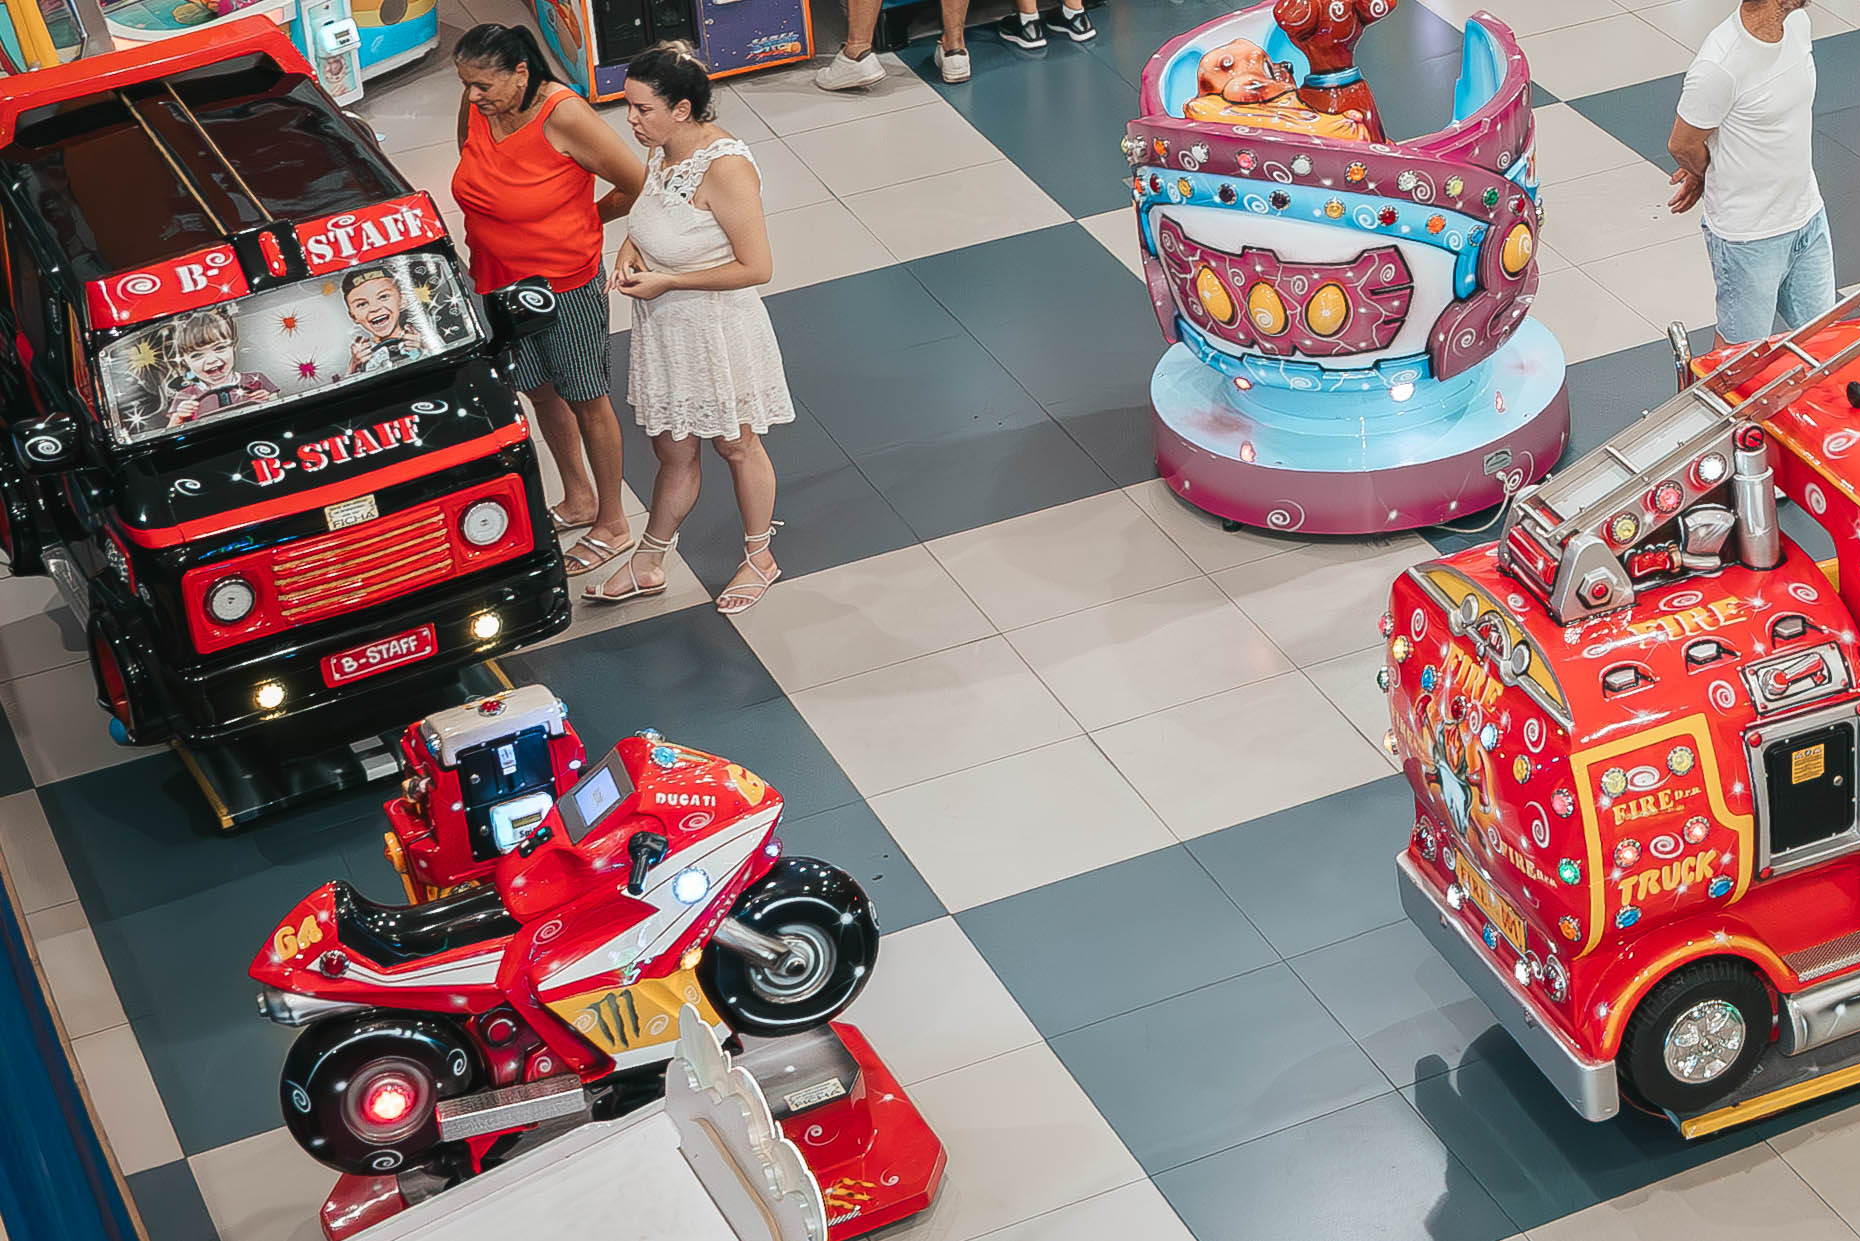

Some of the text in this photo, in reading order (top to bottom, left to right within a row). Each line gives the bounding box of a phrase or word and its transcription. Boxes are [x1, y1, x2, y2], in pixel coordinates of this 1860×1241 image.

[307, 207, 425, 265] STAFF
[251, 415, 419, 487] B-STAFF
[332, 511, 376, 529] FICHA
[341, 635, 418, 673] B-STAFF
[1440, 642, 1504, 713] FIRE
[655, 792, 717, 807] DUCATI
[1612, 788, 1674, 826] FIRE
[1618, 848, 1717, 907] TRUCK
